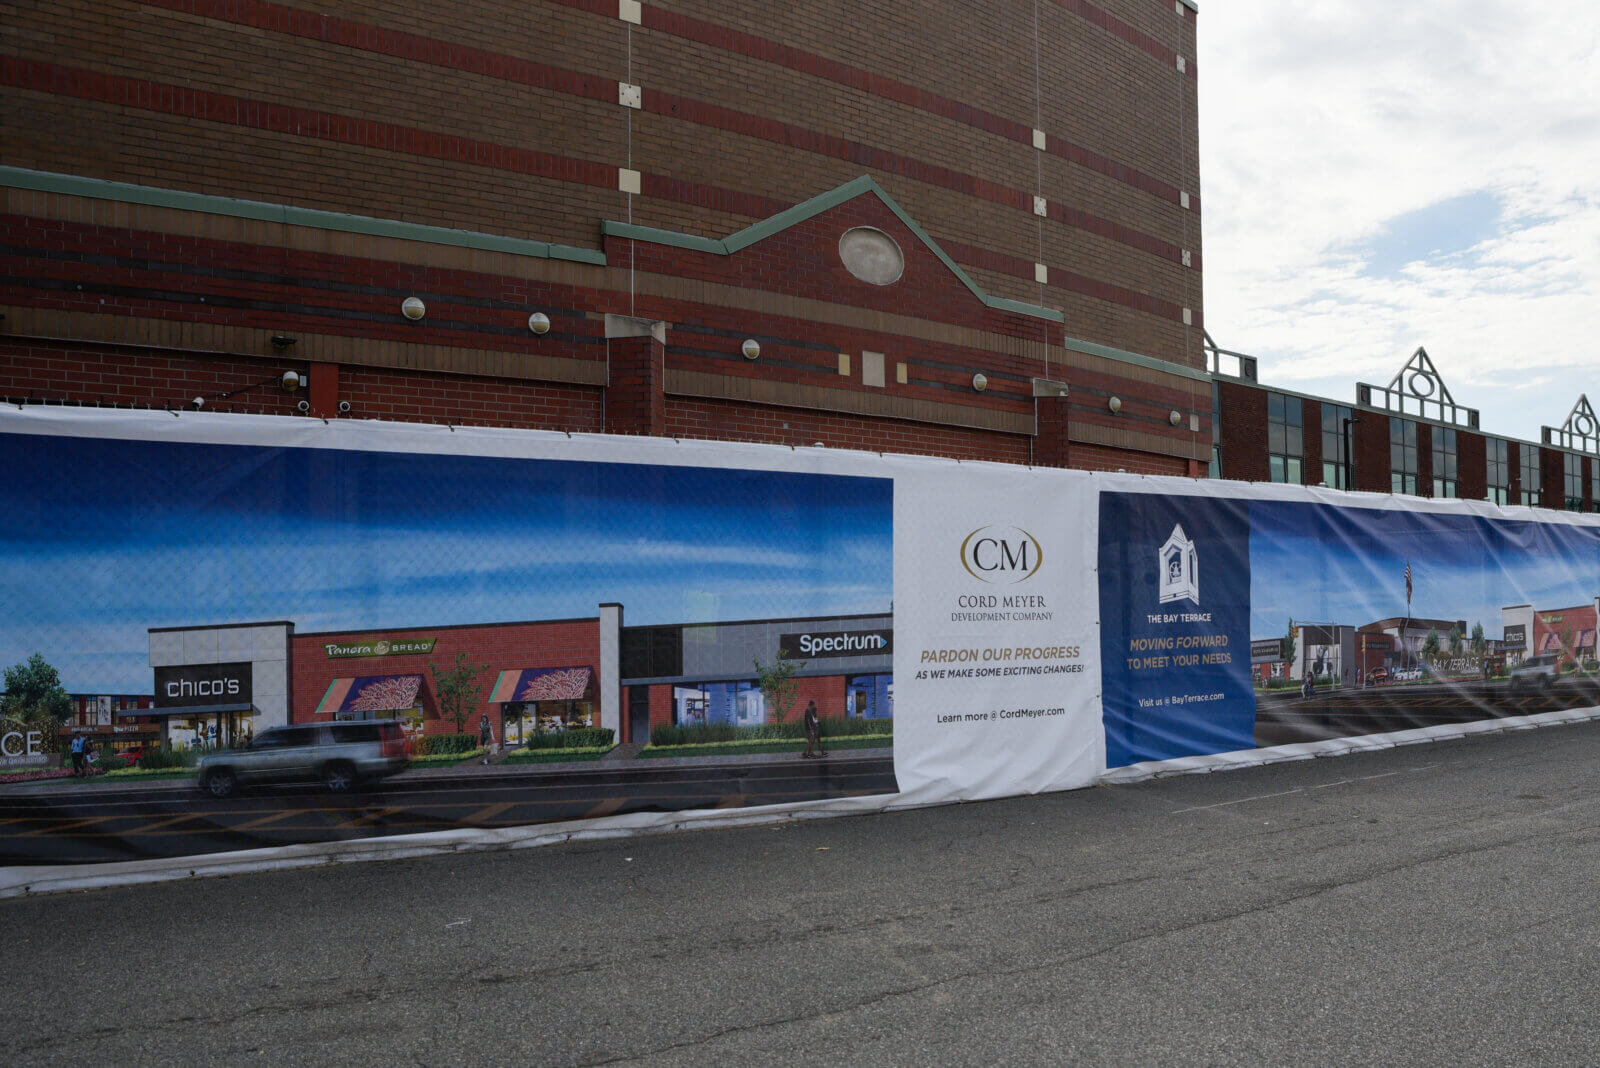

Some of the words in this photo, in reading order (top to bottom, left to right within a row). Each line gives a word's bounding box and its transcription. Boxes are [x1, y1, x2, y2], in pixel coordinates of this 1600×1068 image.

[973, 538, 1028, 571] CM
[958, 595, 997, 608] CORD
[1002, 595, 1047, 608] MEYER
[951, 612, 1011, 622] DEVELOPMENT
[1012, 611, 1053, 621] COMPANY
[1147, 614, 1162, 624] THE
[1163, 614, 1178, 623] BAY
[1180, 613, 1212, 622] TERRACE
[392, 643, 428, 652] BREAD
[799, 632, 881, 656] Spectrum
[1130, 637, 1174, 651] MOVING
[1176, 635, 1228, 649] FORWARD
[920, 649, 979, 663] PARDON
[982, 648, 1011, 661] OUR
[1014, 646, 1081, 660] PROGRESS
[1127, 658, 1141, 670] TO
[1143, 657, 1170, 669] MEET
[1172, 655, 1199, 667] YOUR
[1202, 653, 1232, 665] NEEDS
[915, 670, 928, 680] AS
[930, 670, 945, 679] WE
[947, 668, 973, 678] MAKE
[975, 667, 1002, 677] SOME
[1003, 666, 1042, 676] EXCITING
[1043, 664, 1084, 674] CHANGES!
[1433, 658, 1448, 671] BAY
[167, 677, 239, 698] chico's
[1138, 698, 1154, 708] Visit
[1155, 698, 1163, 706] us
[1171, 692, 1225, 705] BayTerrace.com
[937, 713, 963, 723] Learn
[964, 713, 989, 722] more
[990, 711, 997, 721] @
[999, 706, 1066, 720] CordMeyer.com
